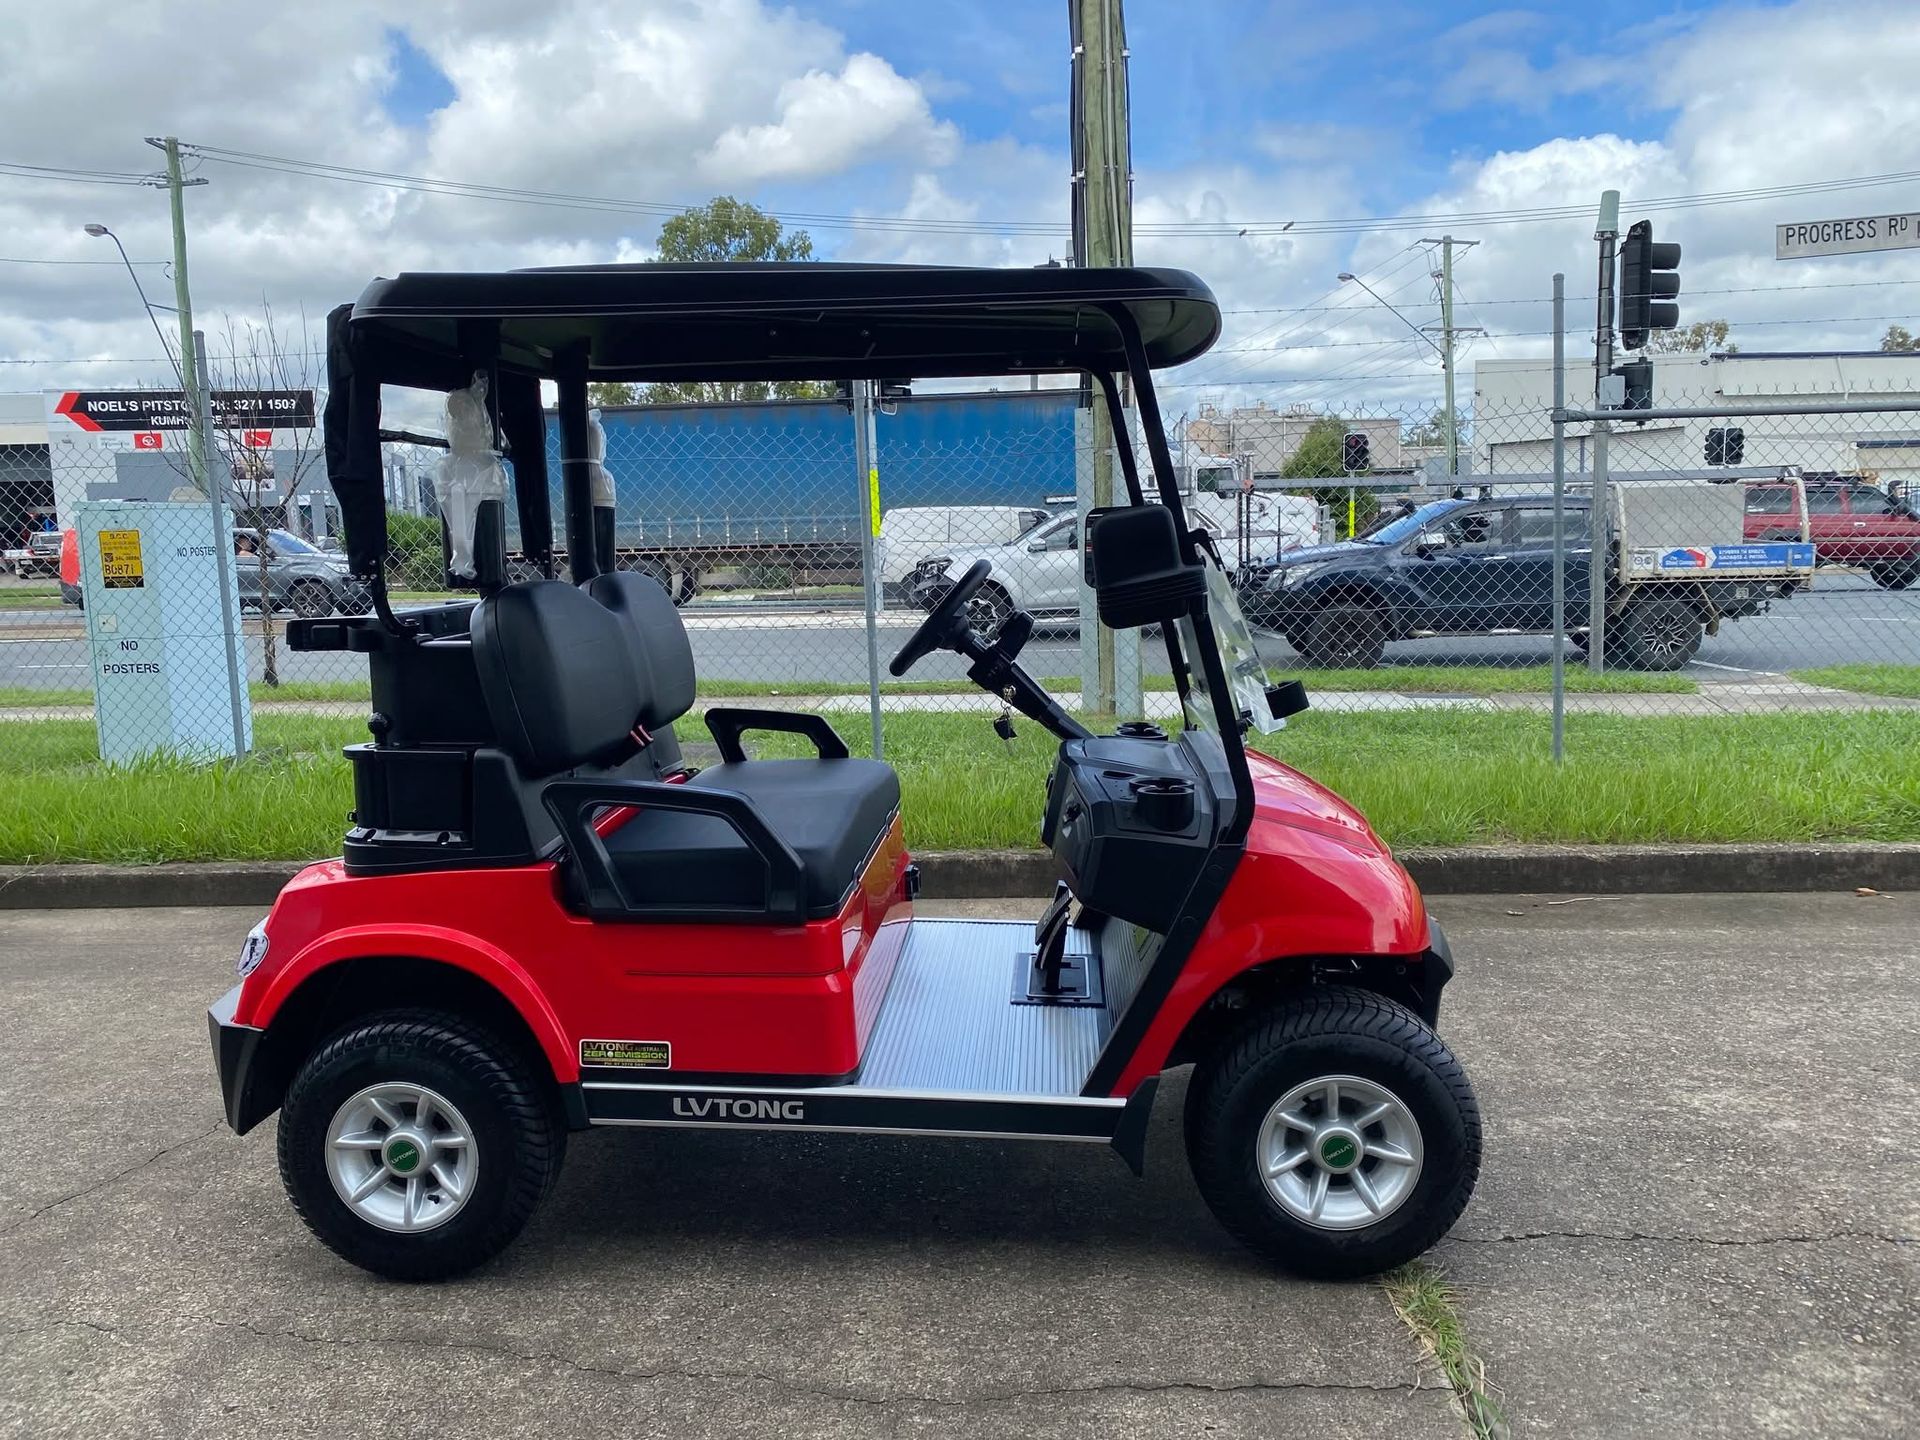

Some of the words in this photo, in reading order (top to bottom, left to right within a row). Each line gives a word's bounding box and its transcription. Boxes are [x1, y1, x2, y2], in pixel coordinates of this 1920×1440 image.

[1785, 219, 1877, 246] PROGRESS
[1888, 217, 1908, 237] RD
[87, 400, 139, 412] NOEL'S
[142, 400, 198, 412] PITSTO
[150, 415, 194, 426] KUMH
[177, 547, 187, 557] NO
[190, 545, 219, 557] POSTER
[120, 640, 139, 651] NO
[103, 663, 160, 674] POSTERS
[583, 1042, 632, 1051] LVTONG
[672, 1097, 804, 1120] LVTONG
